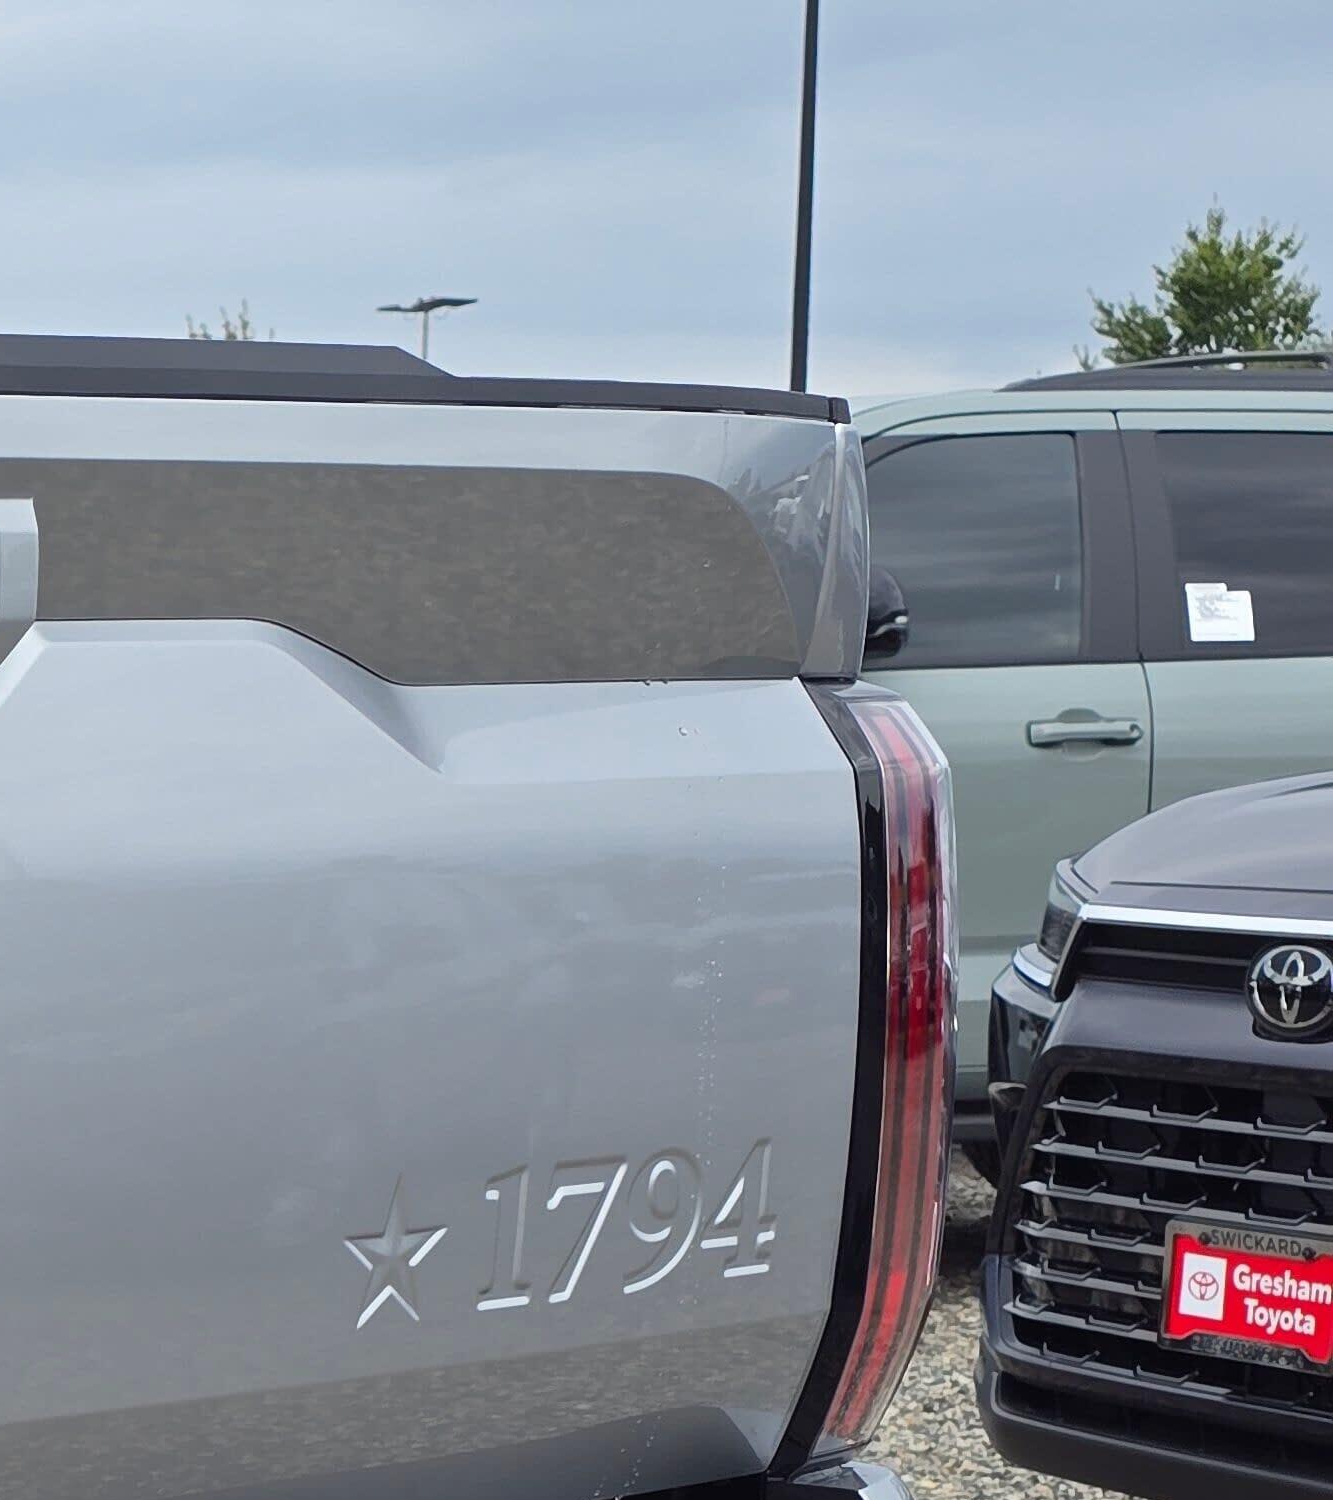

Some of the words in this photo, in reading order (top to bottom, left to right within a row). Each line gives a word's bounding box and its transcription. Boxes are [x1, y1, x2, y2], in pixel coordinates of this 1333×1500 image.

[476, 1136, 777, 1311] 1794
[1210, 1229, 1302, 1257] SWICKARD
[1233, 1264, 1332, 1304] Gresham
[1244, 1298, 1316, 1335] Toyota
